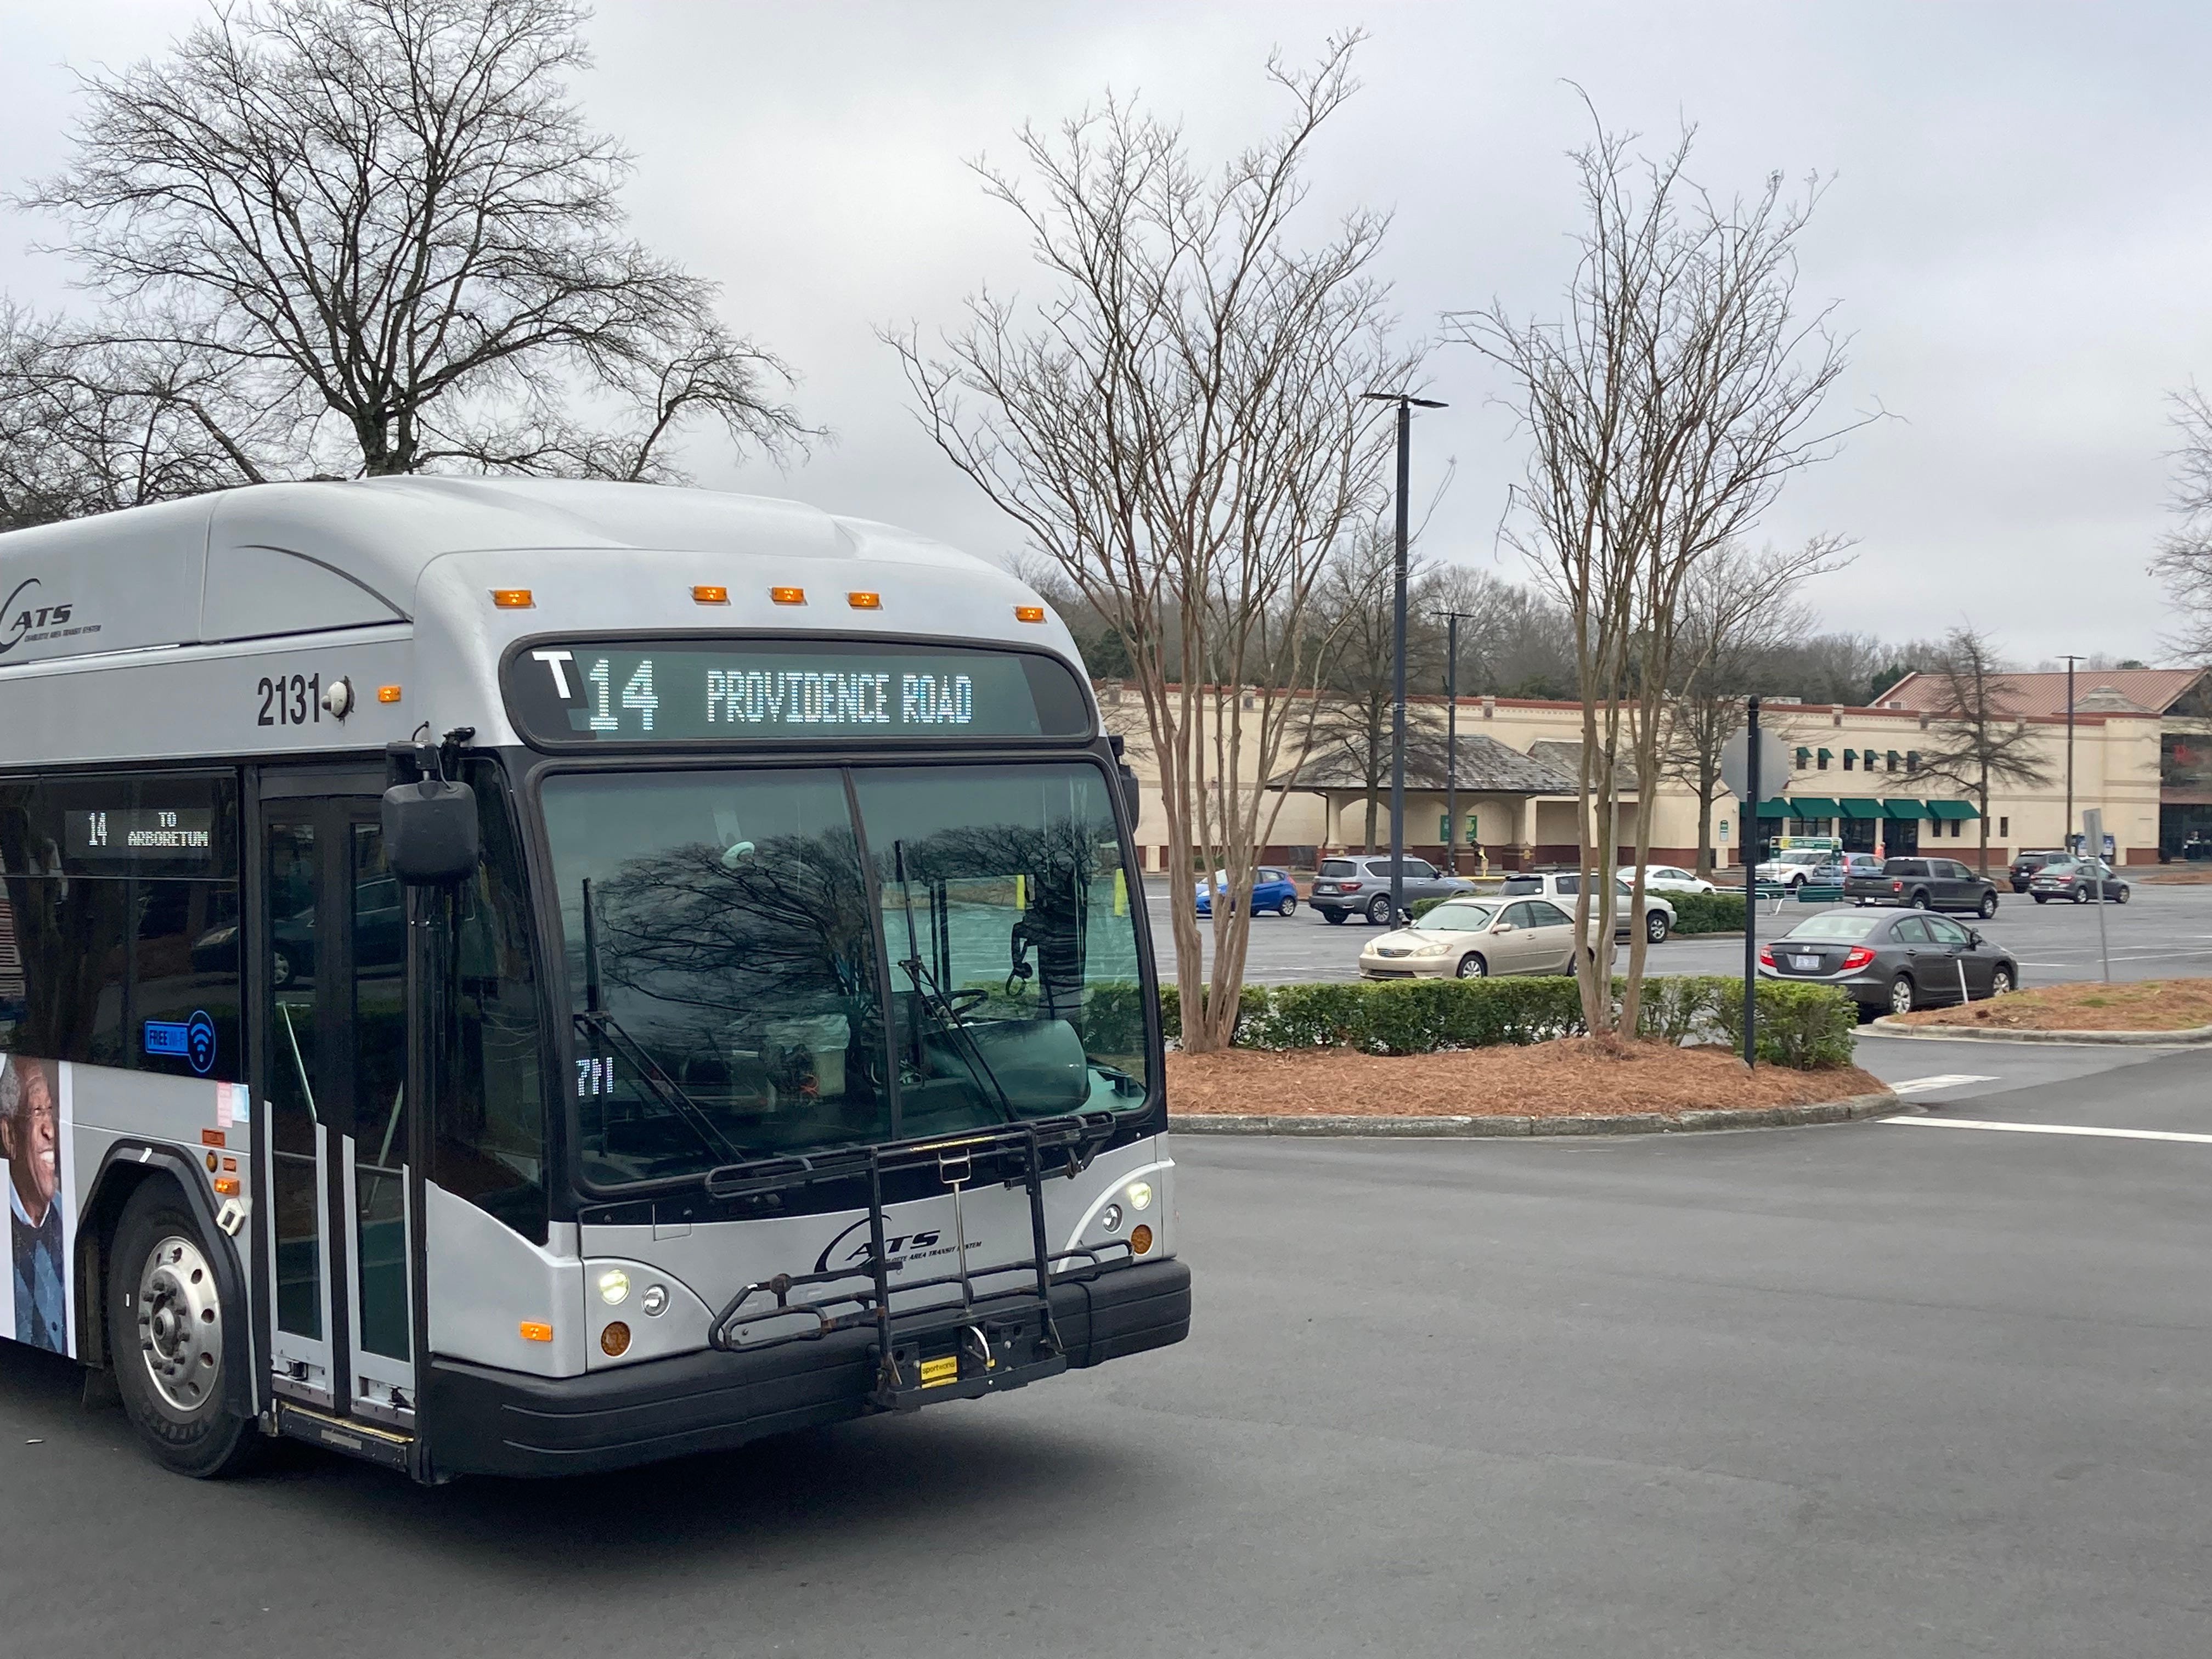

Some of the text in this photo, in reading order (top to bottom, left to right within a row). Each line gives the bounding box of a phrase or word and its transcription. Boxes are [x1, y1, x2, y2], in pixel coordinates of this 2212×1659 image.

[532, 651, 573, 698] T
[258, 673, 319, 726] 2131
[589, 659, 972, 731] 14 PROVIDENCE ROAD
[88, 812, 177, 846] 14 TO
[127, 831, 208, 847] ARBORETUM
[149, 1029, 168, 1046] FREE
